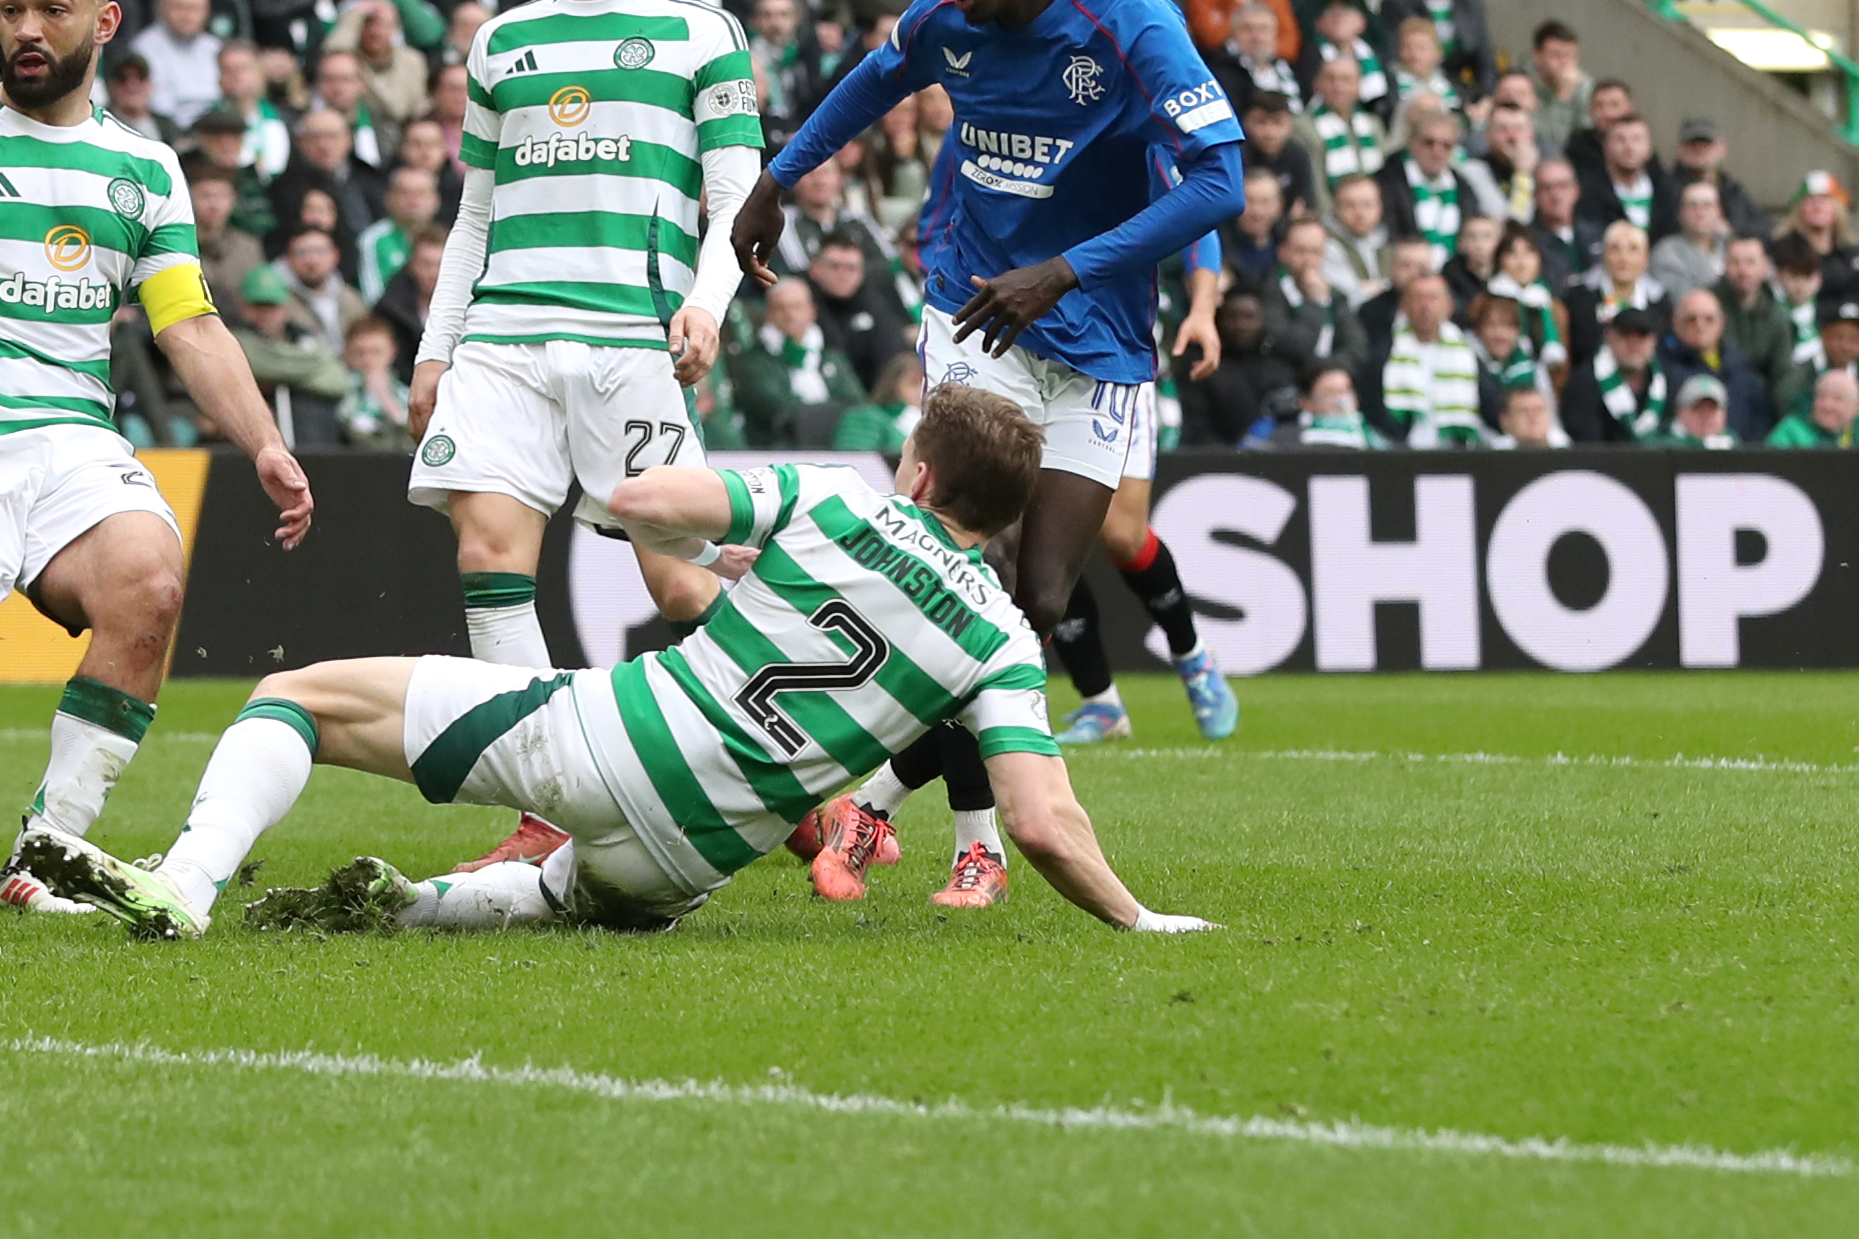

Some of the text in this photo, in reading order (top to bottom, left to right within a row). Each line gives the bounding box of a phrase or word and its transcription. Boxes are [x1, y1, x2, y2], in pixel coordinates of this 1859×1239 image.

[1163, 79, 1223, 118] BOXT
[514, 131, 632, 169] dafabet
[960, 121, 1074, 165] UNIBET
[625, 420, 685, 477] 27
[842, 528, 975, 640] JOHNSTON
[874, 506, 993, 607] MAGNERS
[1144, 469, 1826, 677] SHOP
[730, 598, 891, 761] 2
